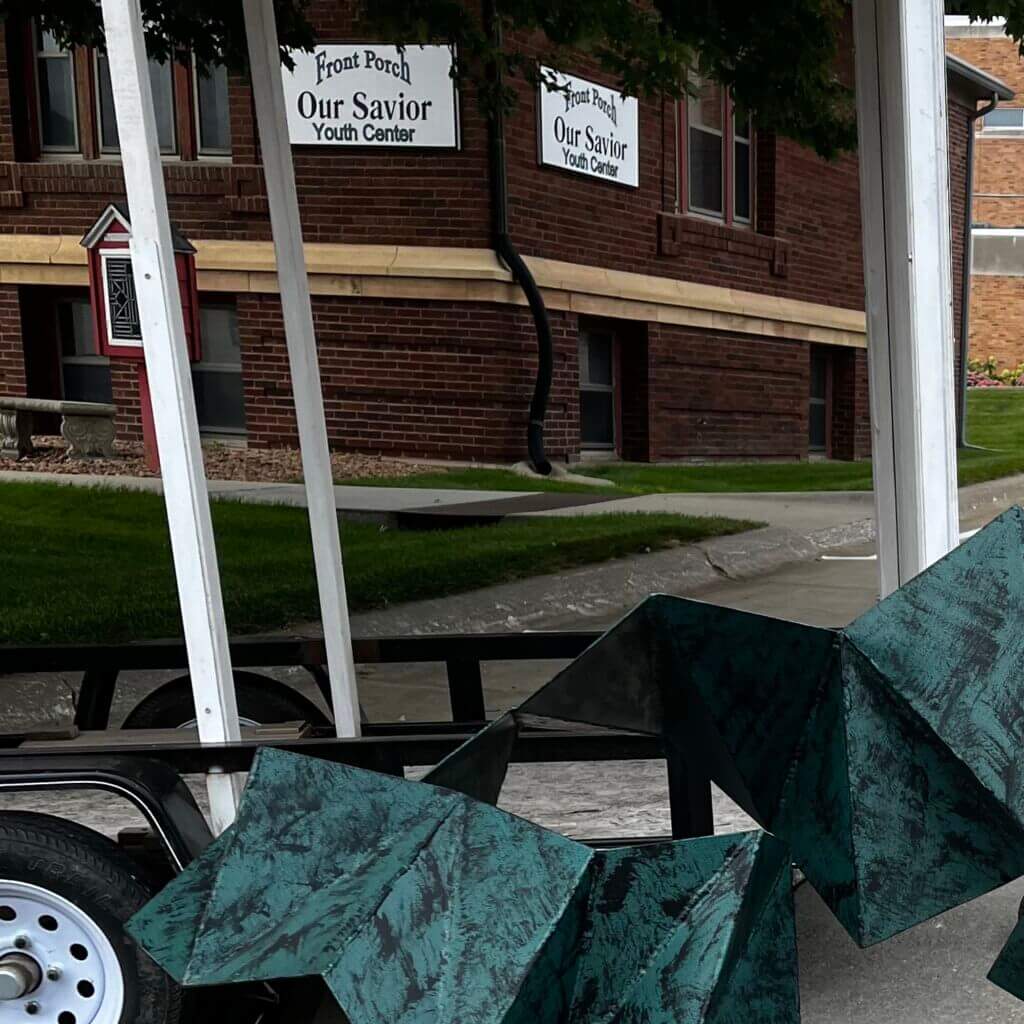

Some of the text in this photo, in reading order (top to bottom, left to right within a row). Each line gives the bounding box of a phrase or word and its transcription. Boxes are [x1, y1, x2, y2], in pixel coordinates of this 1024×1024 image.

[315, 49, 411, 86] Front Porch
[297, 90, 433, 121] Our Savior
[564, 80, 618, 128] Front Porch
[312, 122, 416, 143] Youth Center
[554, 115, 628, 161] Our Savior
[562, 146, 619, 177] Youth Center
